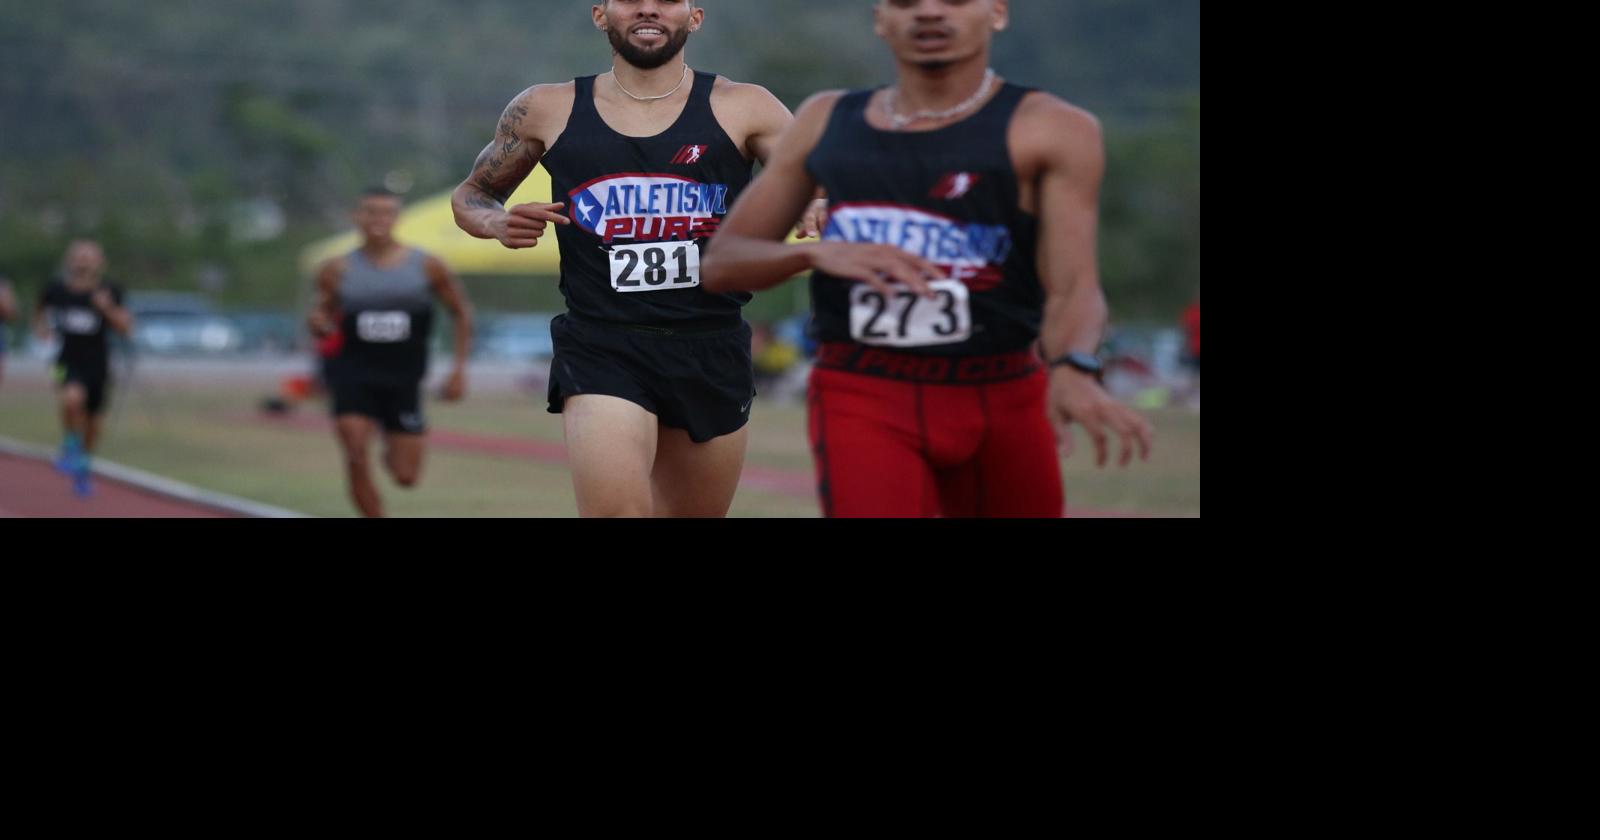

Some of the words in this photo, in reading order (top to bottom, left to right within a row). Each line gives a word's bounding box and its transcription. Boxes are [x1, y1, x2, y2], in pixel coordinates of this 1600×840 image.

[605, 183, 728, 216] ATLETISMO
[614, 246, 692, 287] 281
[860, 290, 958, 338] 273
